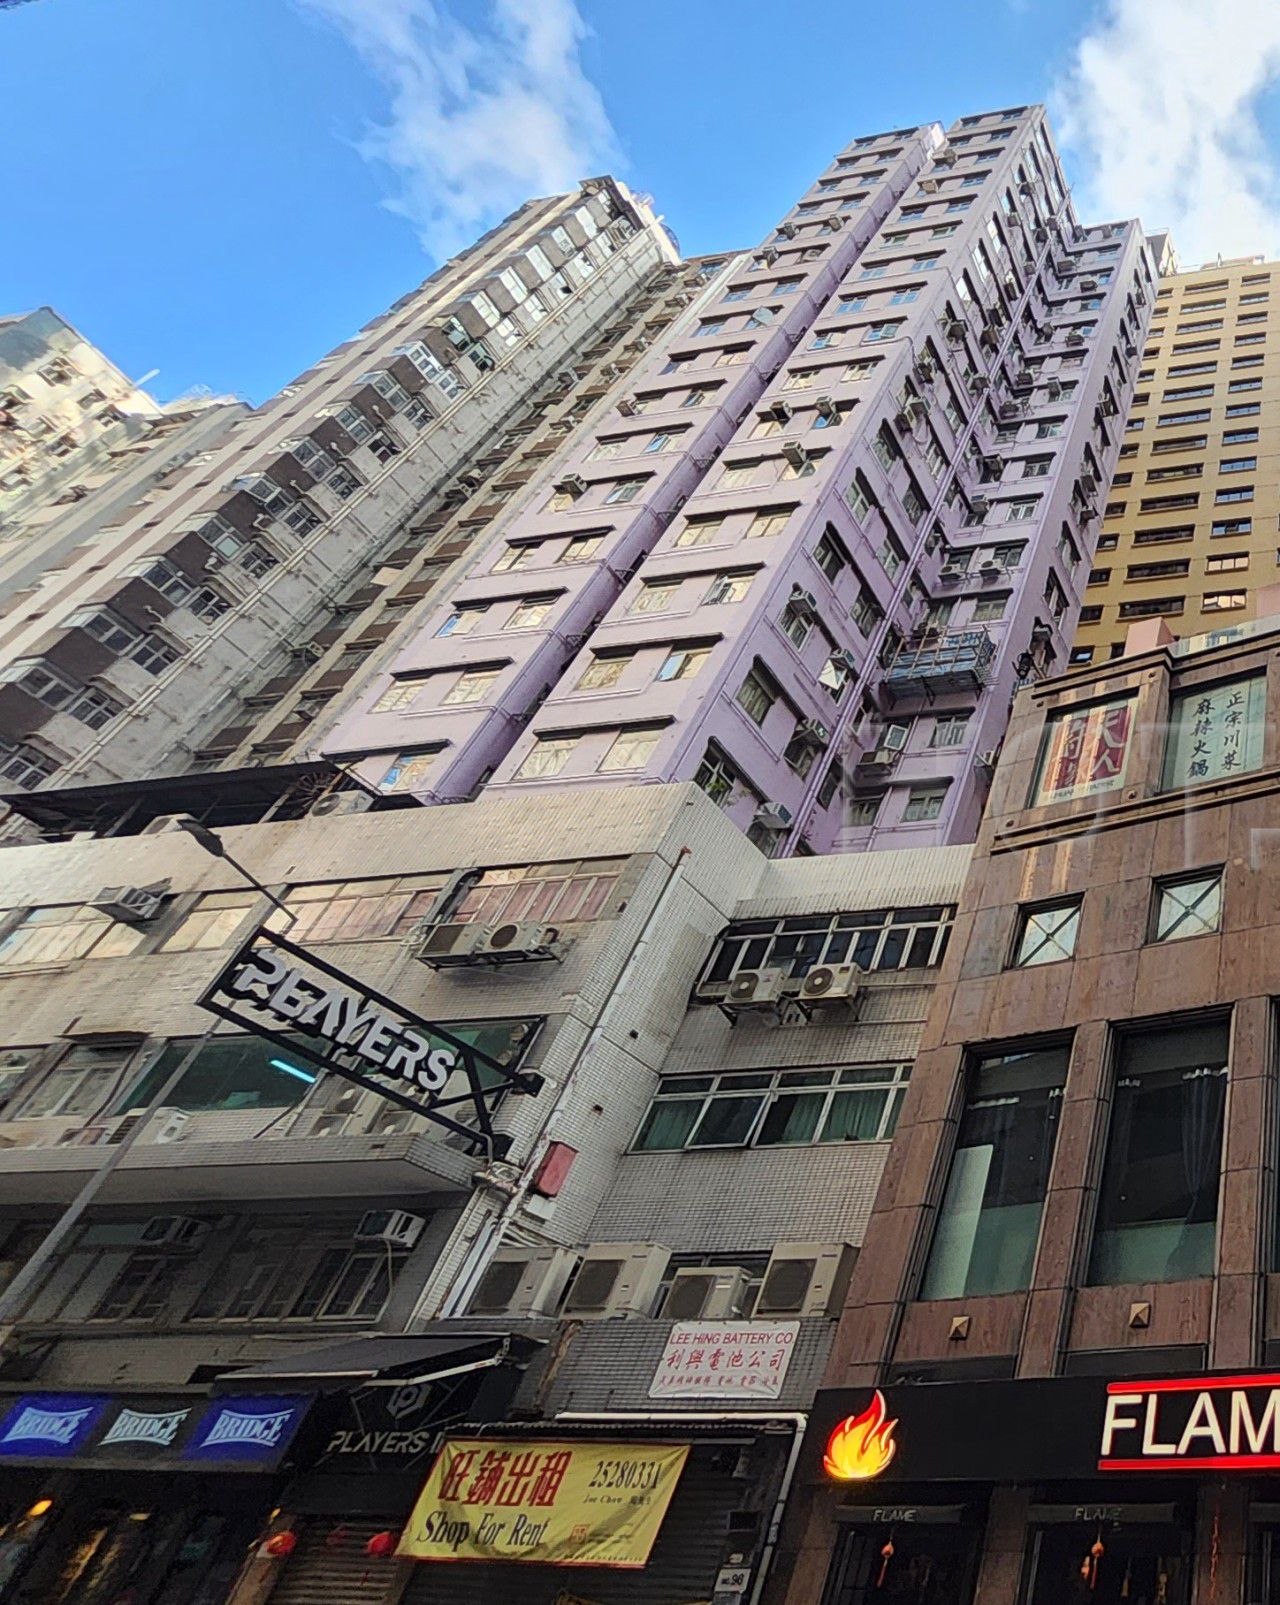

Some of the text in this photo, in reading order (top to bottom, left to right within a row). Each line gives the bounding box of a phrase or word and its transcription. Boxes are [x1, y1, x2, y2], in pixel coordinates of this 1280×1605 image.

[1187, 698, 1216, 779] 麻辣火鍋
[1221, 690, 1246, 771] 正宗川菜
[232, 949, 456, 1092] PLAYERS
[669, 1333, 692, 1345] LEE
[692, 1333, 721, 1345] HING
[722, 1332, 773, 1344] BATTERY
[12, 1411, 86, 1440] BRIDGE
[107, 1411, 188, 1440] BRIDGE
[208, 1414, 291, 1442] BRIDGE
[326, 1430, 430, 1454] PLAYERS
[588, 1461, 662, 1489] 25280331
[872, 1509, 917, 1523] FLAME
[416, 1510, 470, 1552] Shop
[475, 1511, 504, 1547] For
[506, 1512, 551, 1547] Rent
